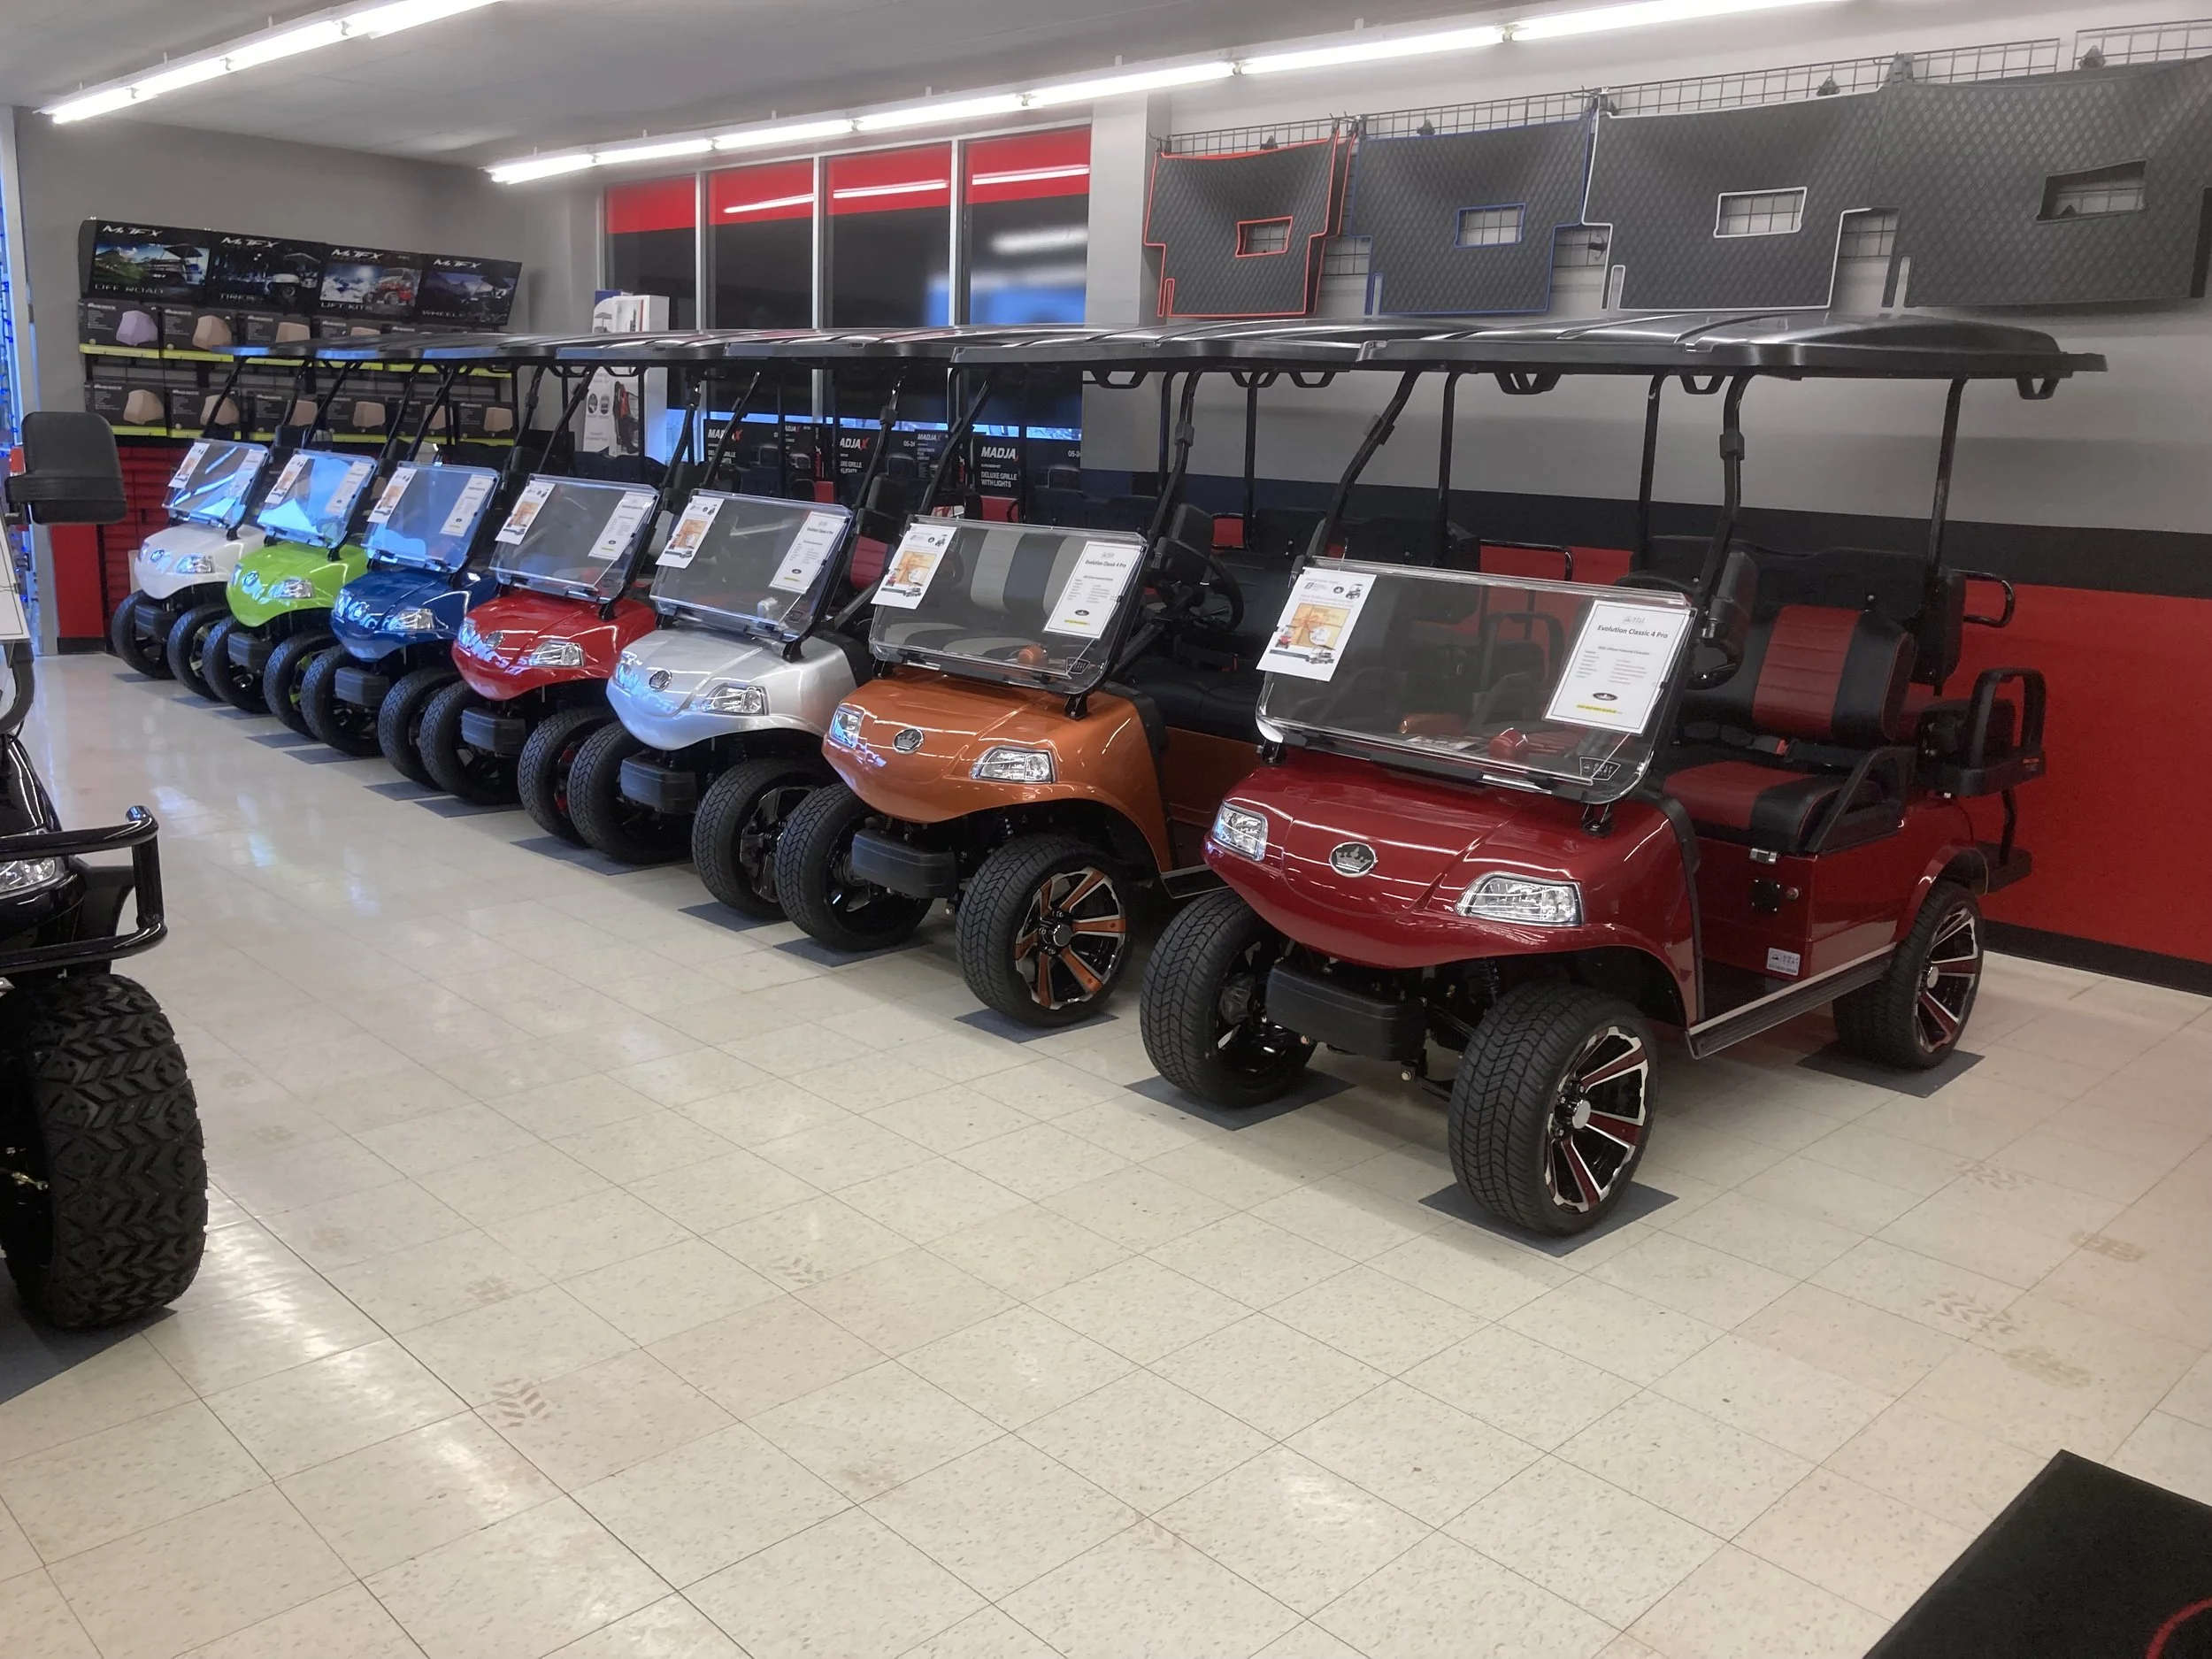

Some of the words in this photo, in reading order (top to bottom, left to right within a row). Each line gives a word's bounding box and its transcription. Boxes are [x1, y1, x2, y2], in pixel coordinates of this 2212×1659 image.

[840, 437, 870, 450] ADJAX
[981, 446, 1018, 460] MADJA
[981, 471, 1000, 480] DELUXE
[1597, 625, 1627, 634] Evolution
[1629, 628, 1650, 637] Classic
